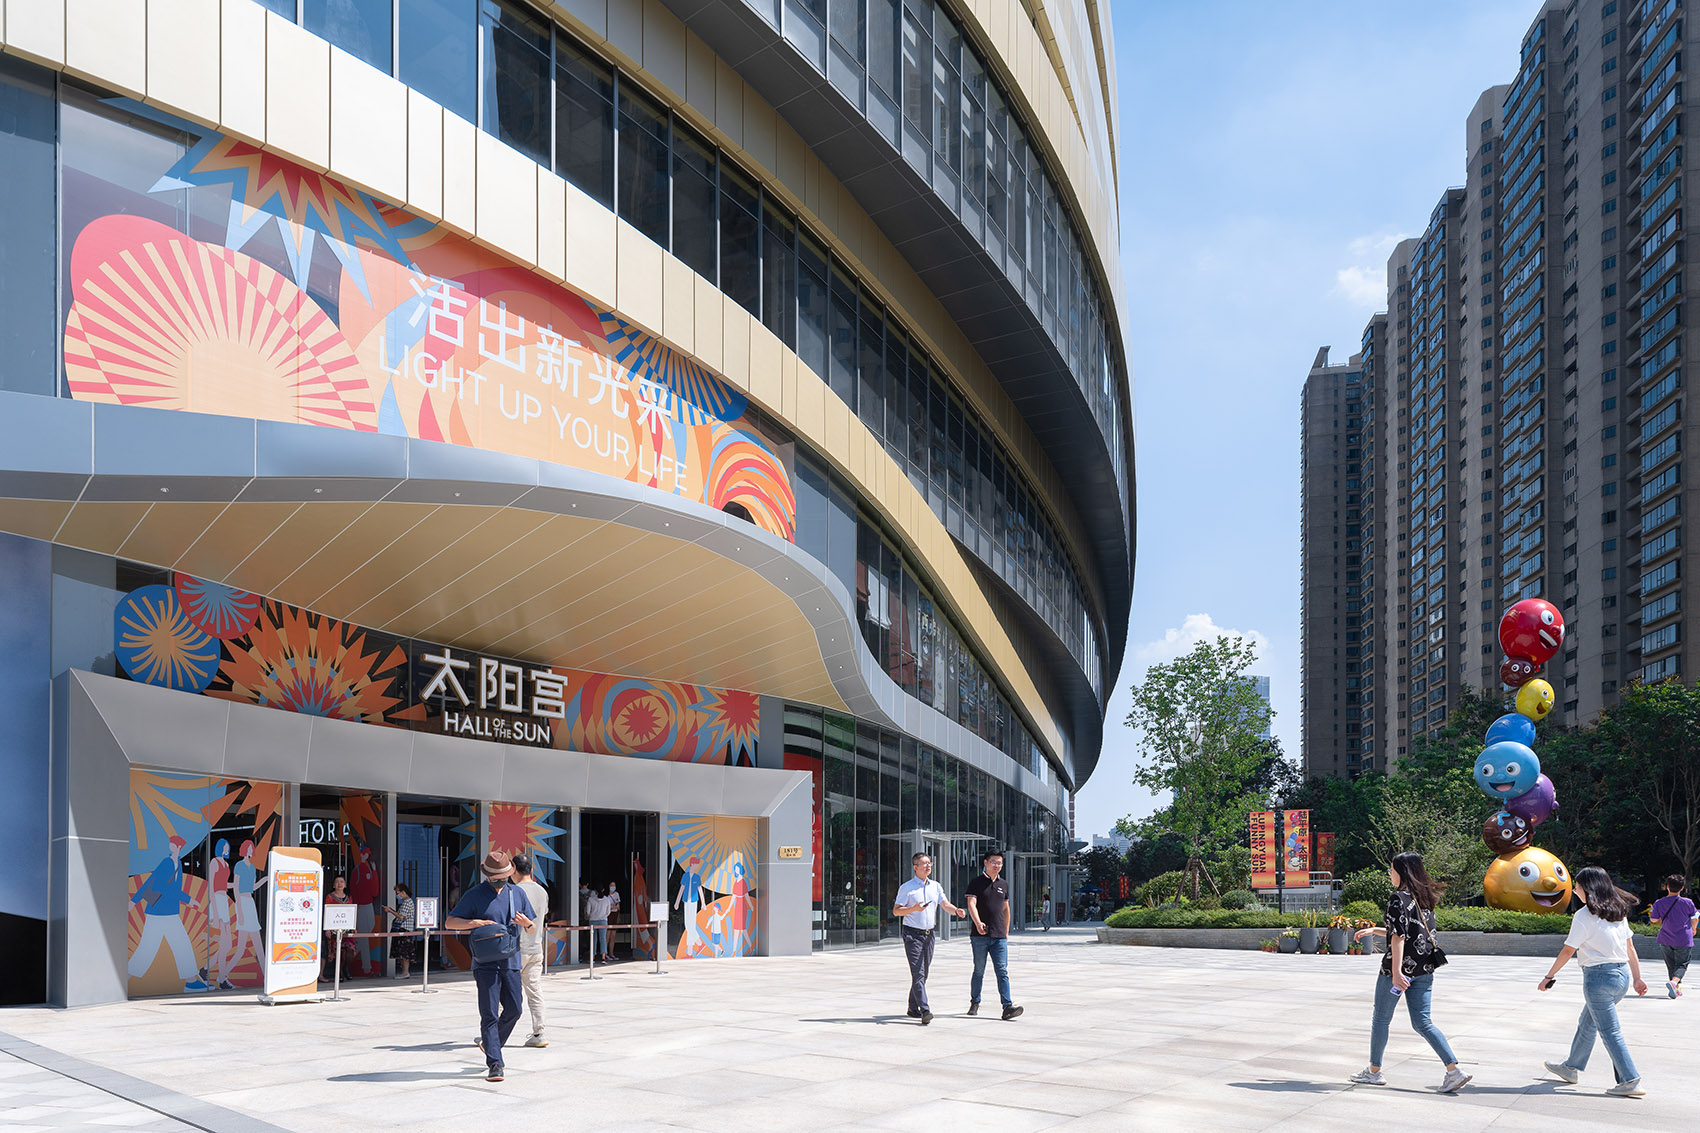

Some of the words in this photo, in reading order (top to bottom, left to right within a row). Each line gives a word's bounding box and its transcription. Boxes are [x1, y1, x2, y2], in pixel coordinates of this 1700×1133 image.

[407, 262, 672, 440] 活出新光采
[379, 336, 488, 406] LIGHT
[499, 383, 542, 425] UP
[551, 405, 631, 467] YOUR
[638, 444, 688, 493] LIFE
[420, 648, 568, 719] 太阳宫
[443, 710, 493, 737] HALL
[492, 717, 506, 728] OF
[493, 727, 512, 739] THE
[512, 720, 551, 744] SUN
[1251, 817, 1259, 851] FUNNY
[1258, 812, 1266, 873] LUPINGYUAN
[1251, 853, 1259, 874] SUN
